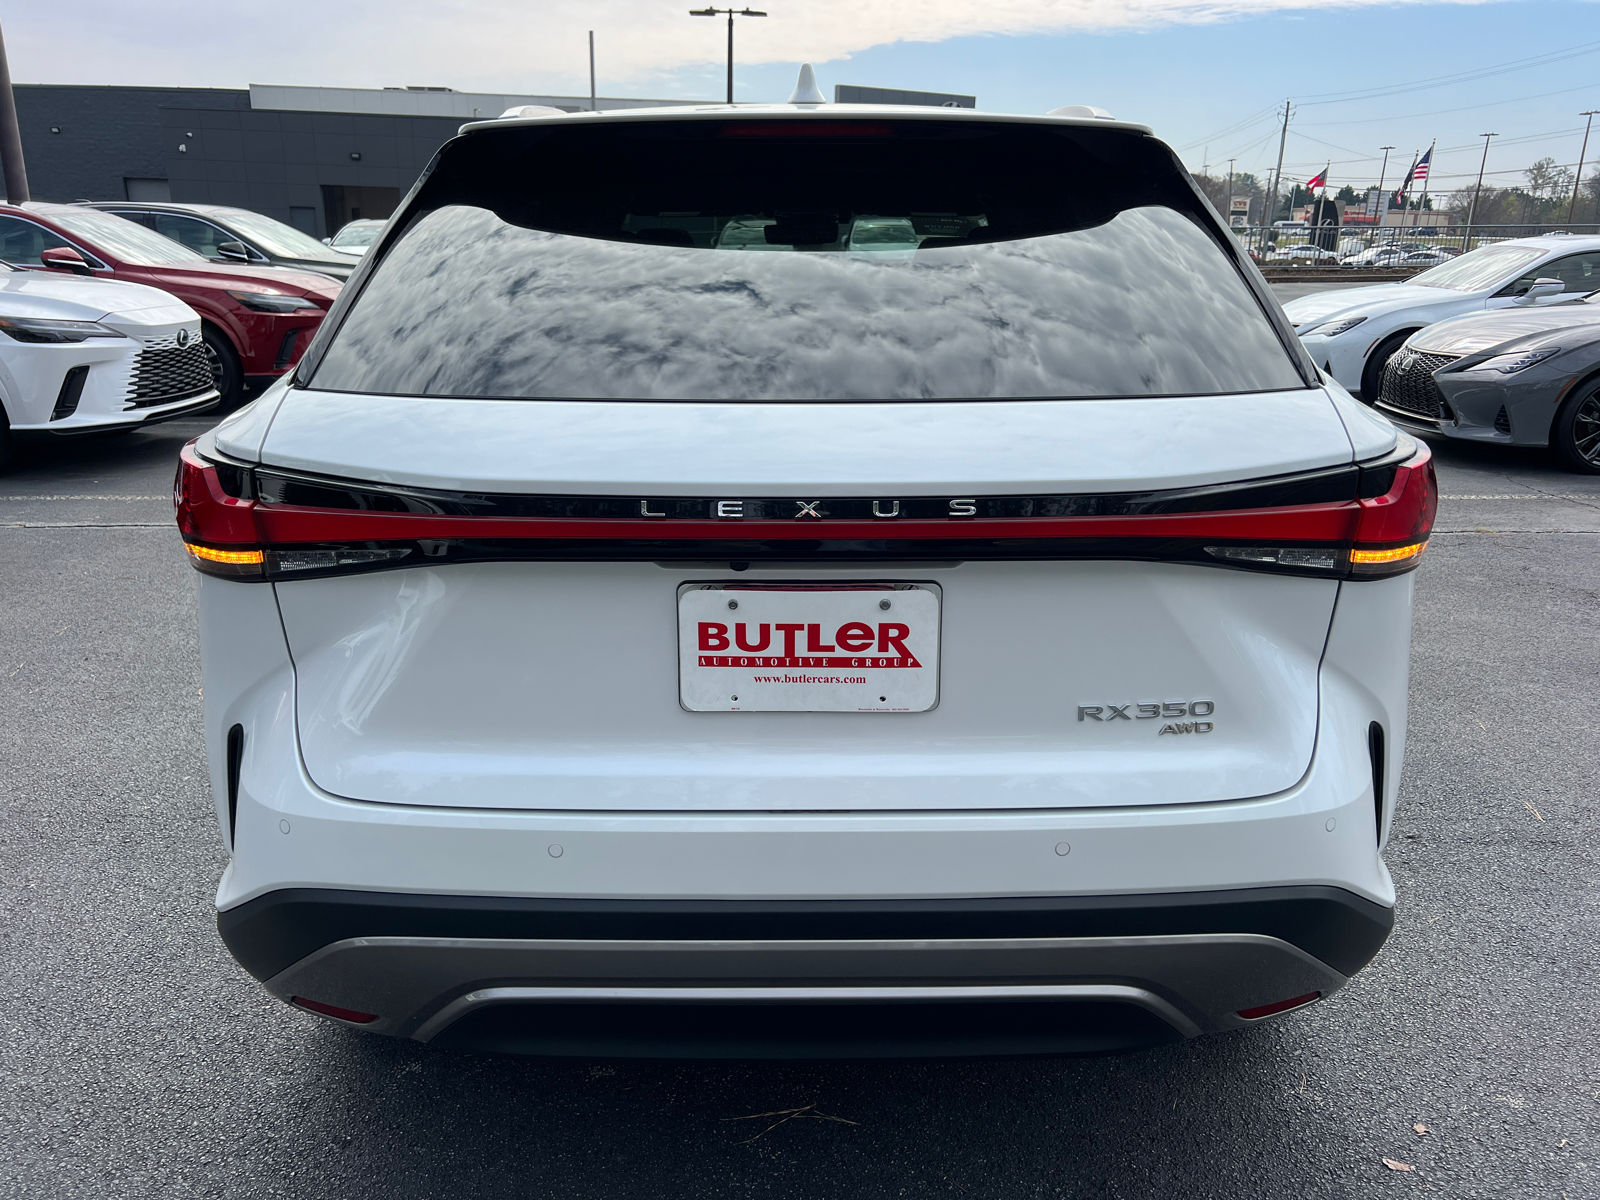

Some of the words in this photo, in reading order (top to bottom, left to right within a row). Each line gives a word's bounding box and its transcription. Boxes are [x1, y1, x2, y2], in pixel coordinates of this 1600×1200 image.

[640, 499, 978, 518] LEXUS
[699, 657, 829, 667] AUTOMOTIVE
[851, 657, 914, 667] GROUP
[753, 674, 867, 684] www.butlercars.com
[1158, 720, 1214, 735] AWD
